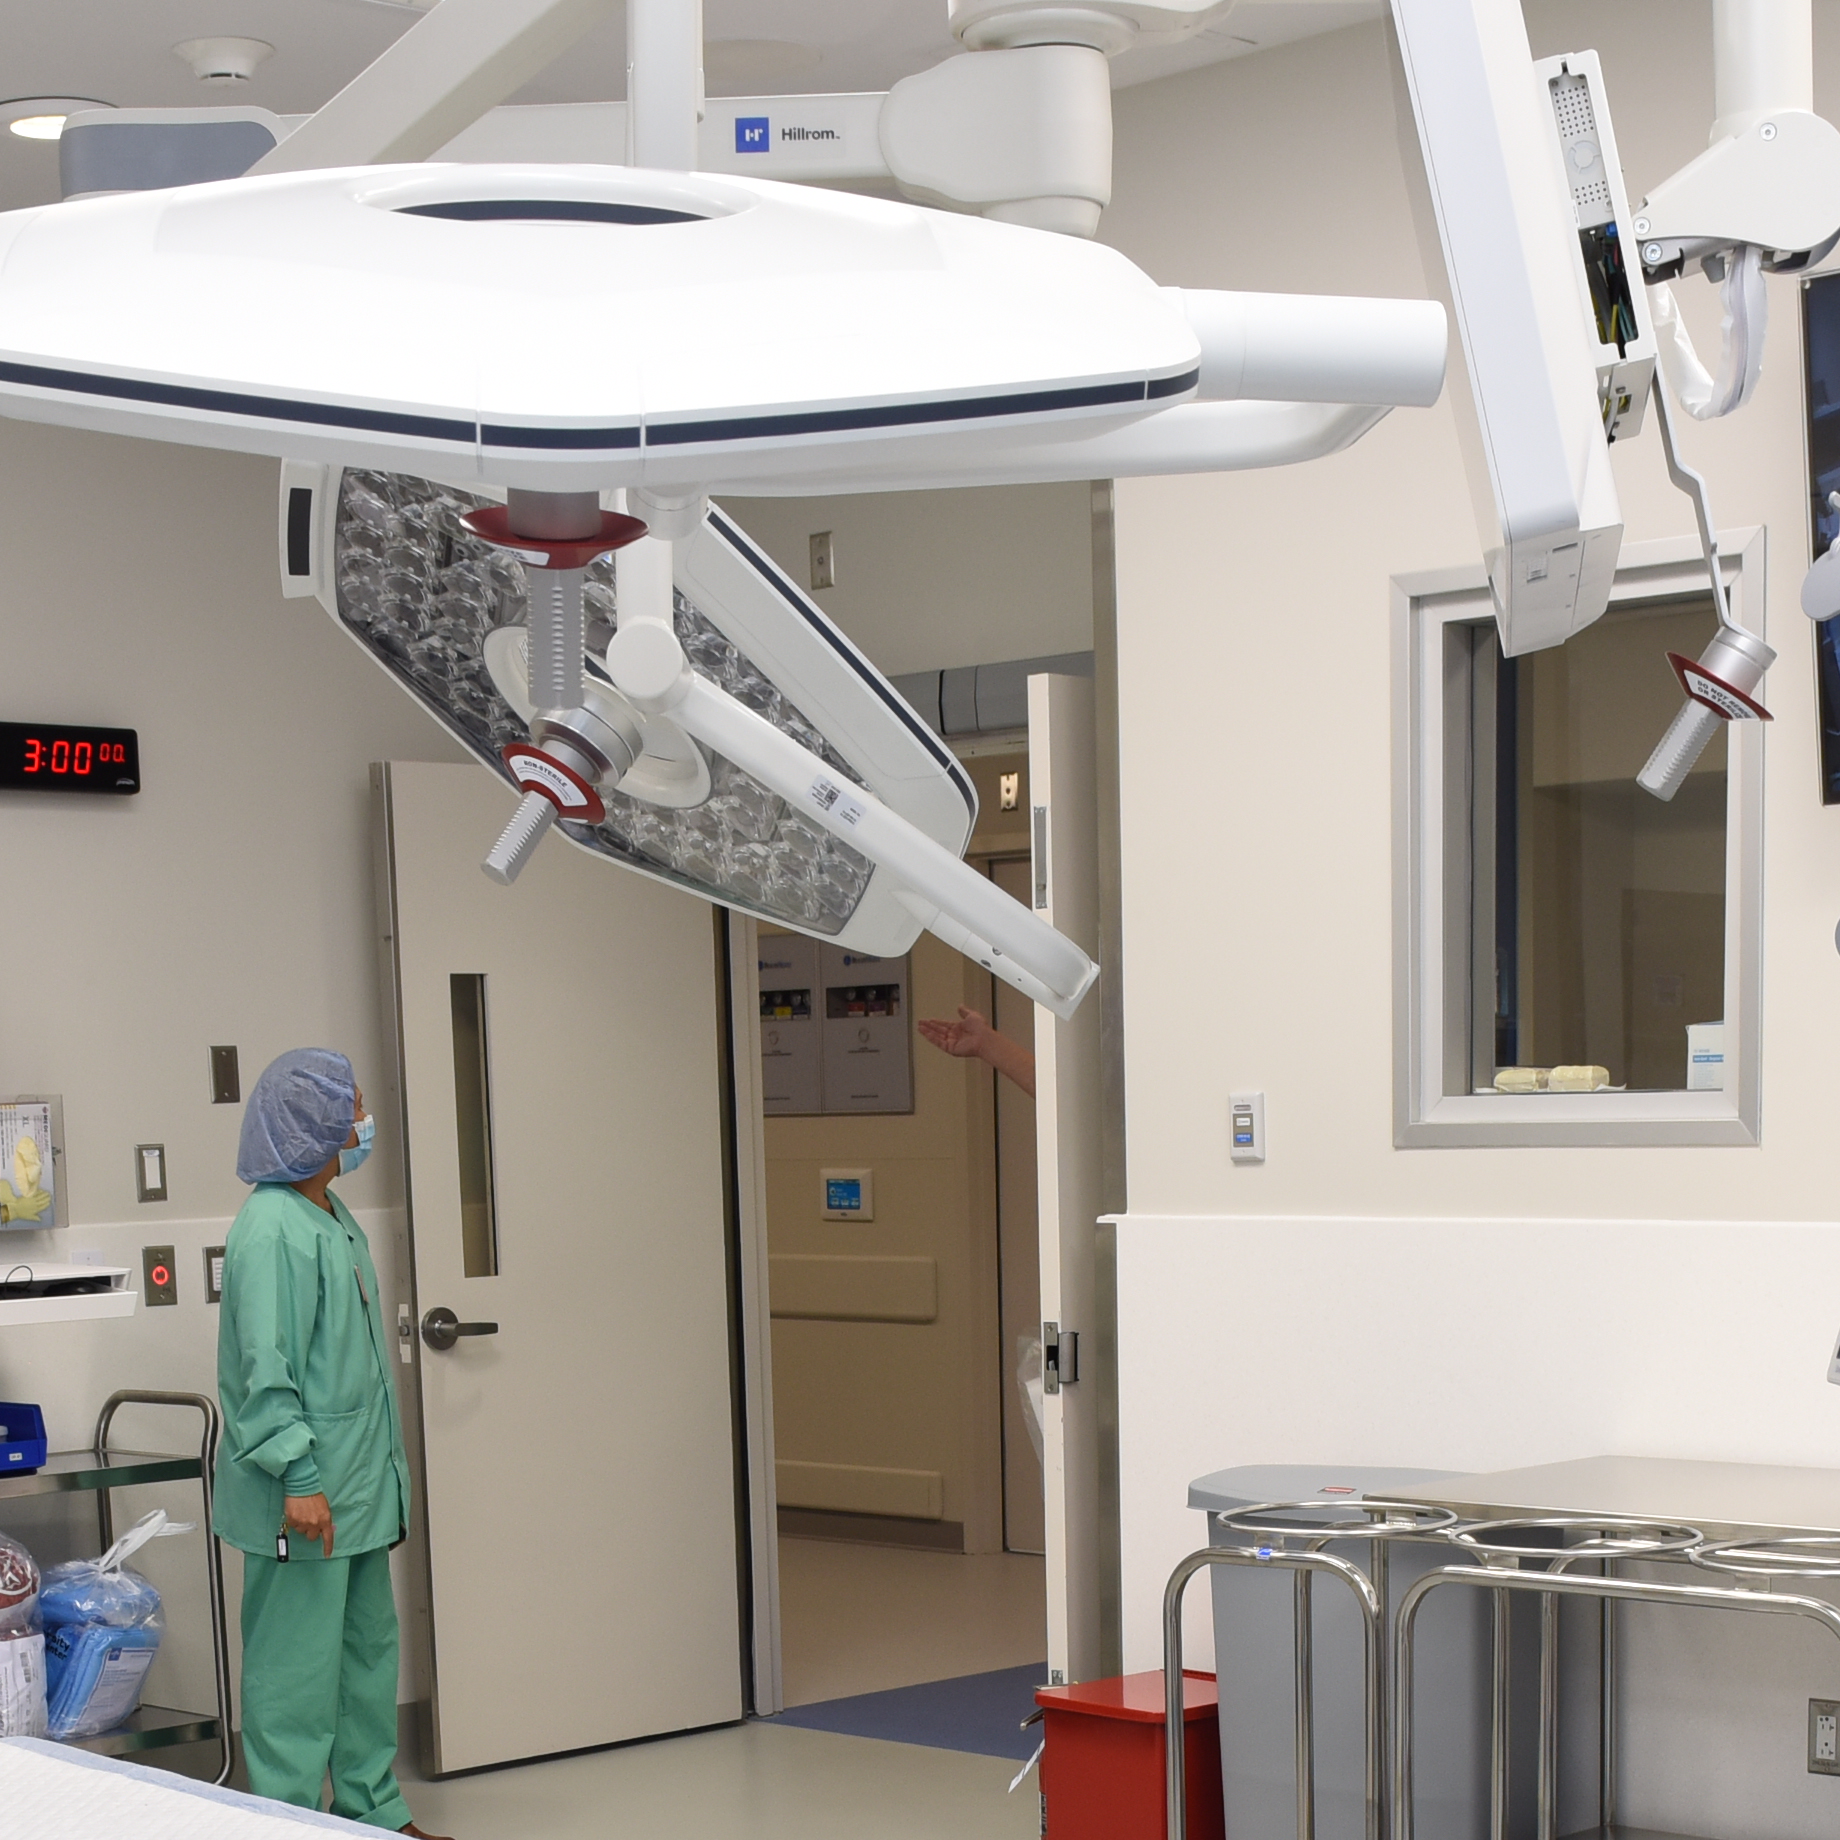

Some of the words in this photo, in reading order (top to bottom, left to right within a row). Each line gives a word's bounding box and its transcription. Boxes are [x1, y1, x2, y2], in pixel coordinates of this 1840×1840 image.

[781, 126, 835, 141] Hillrom
[1697, 680, 1709, 690] DO
[1710, 688, 1728, 701] NOT
[1698, 687, 1709, 696] OR
[23, 739, 92, 775] 3:00
[523, 759, 568, 788] NON-STERILE
[21, 1115, 30, 1128] XL
